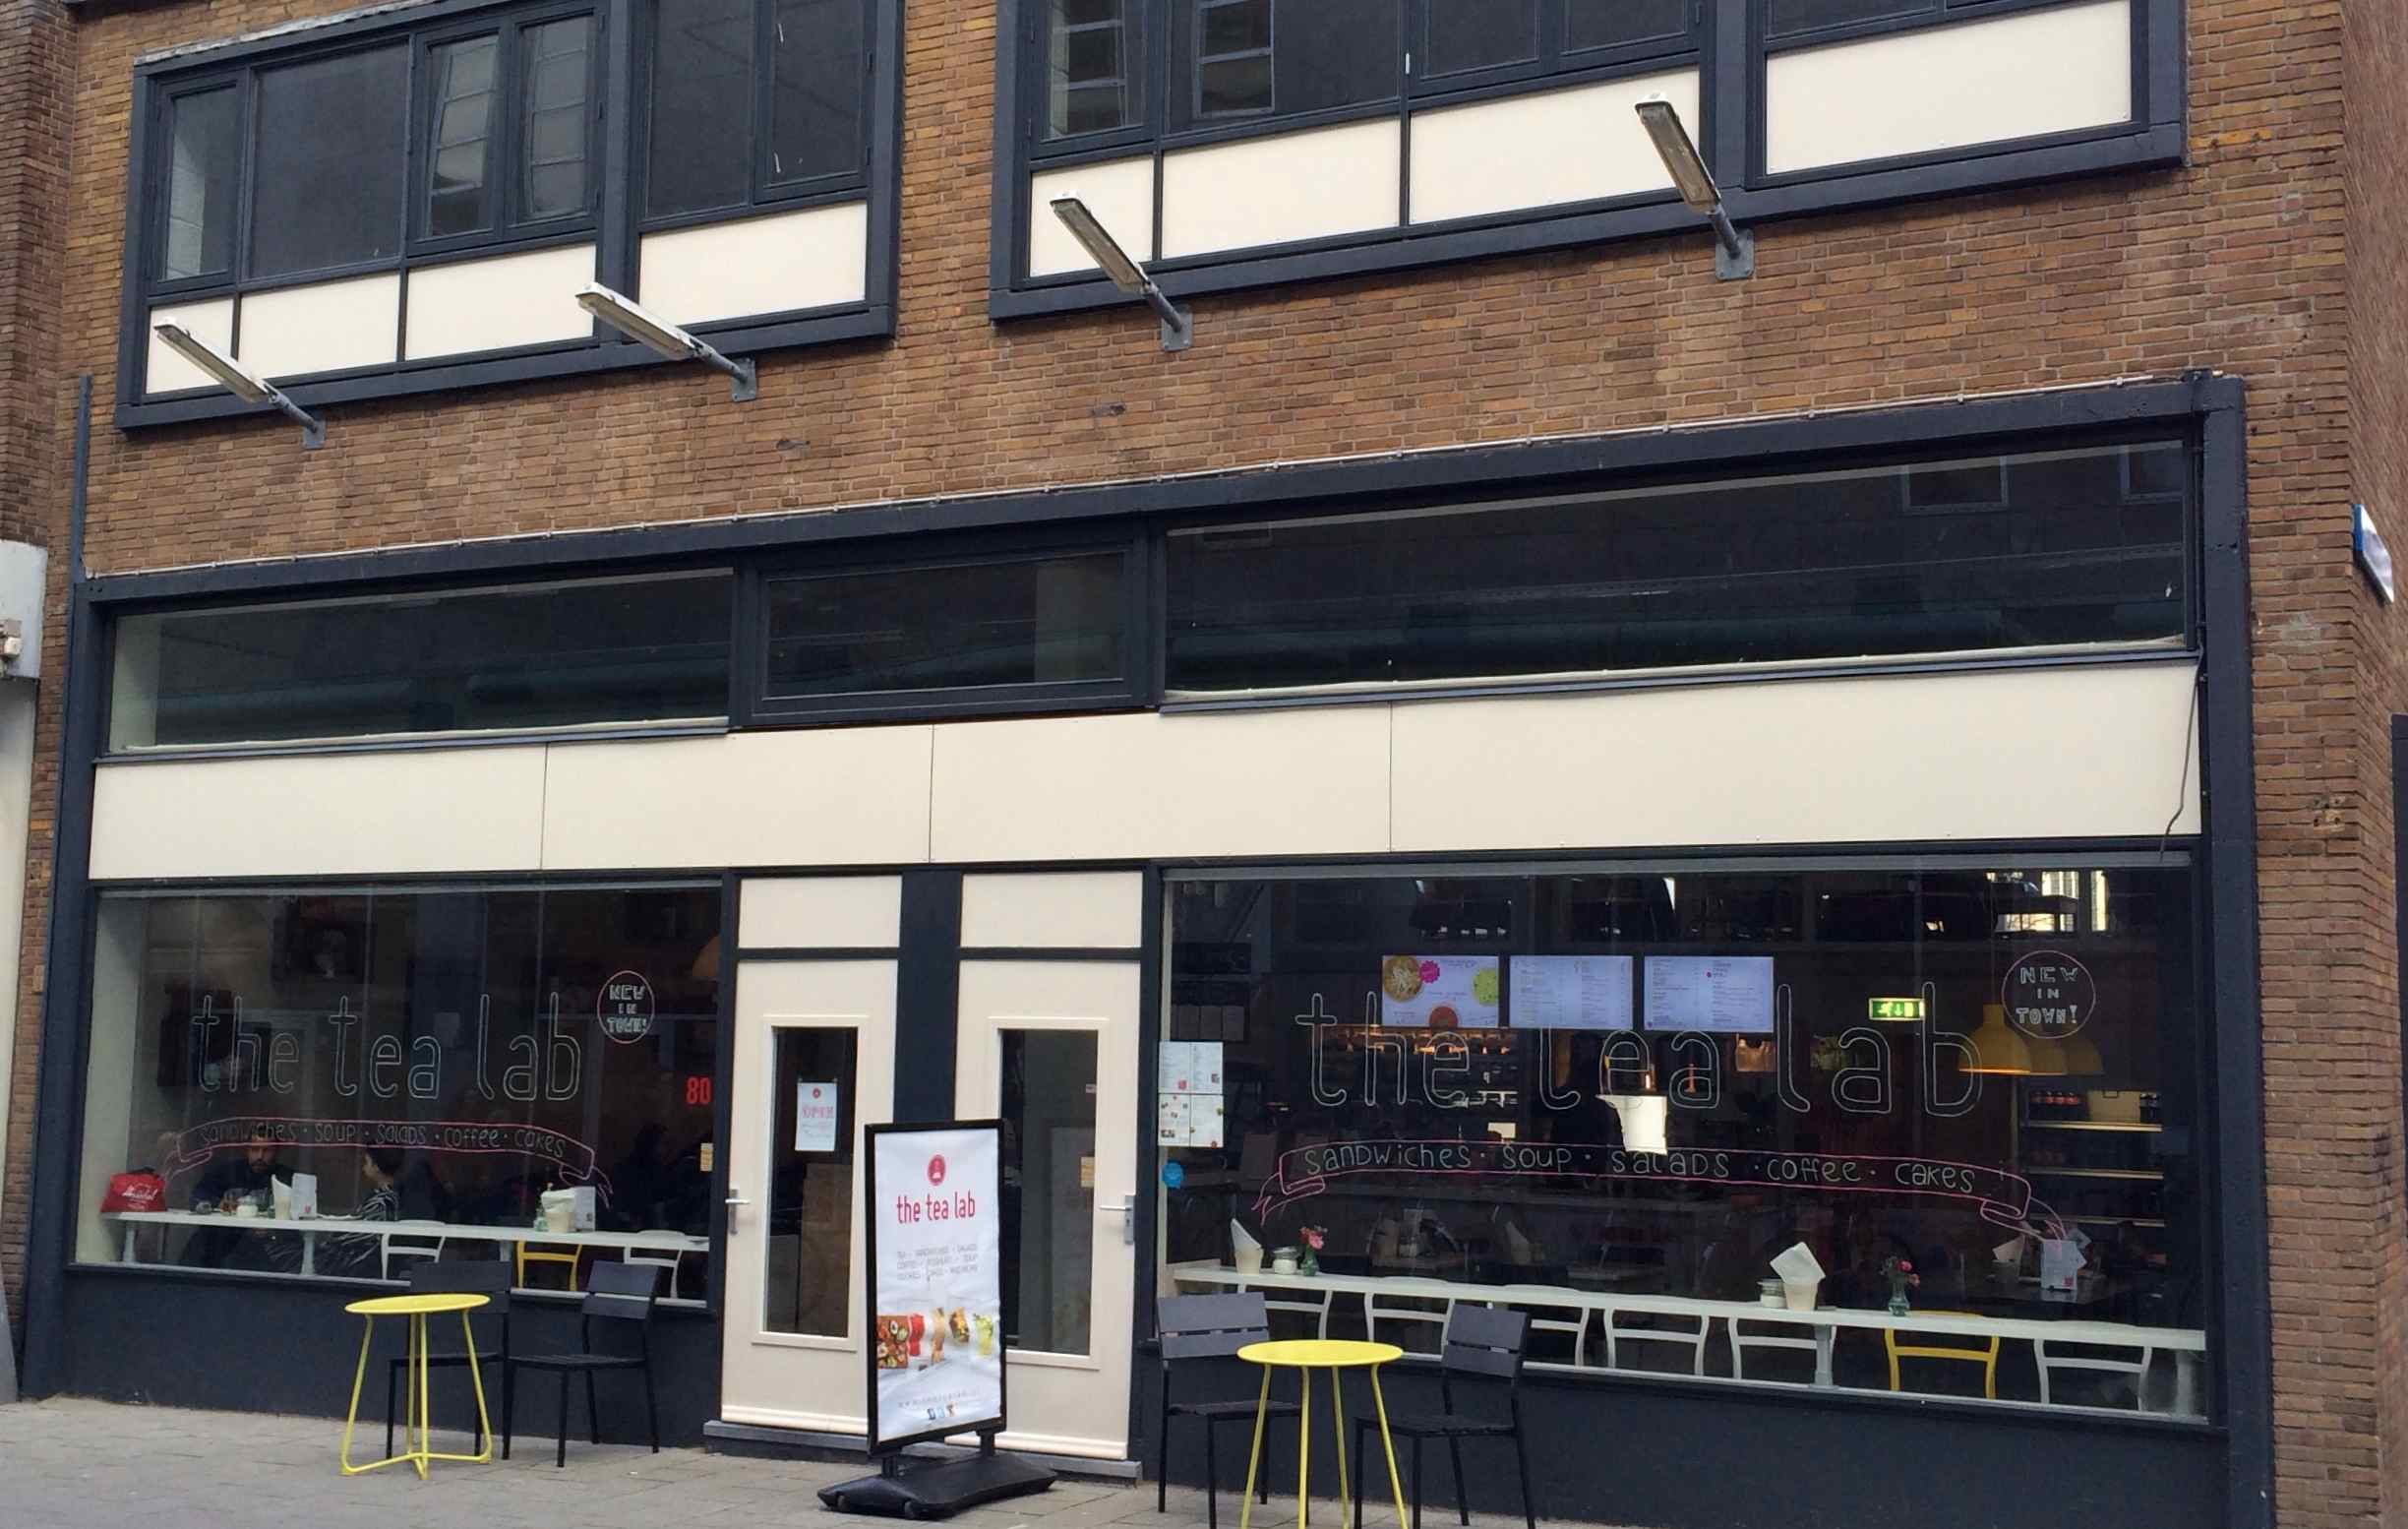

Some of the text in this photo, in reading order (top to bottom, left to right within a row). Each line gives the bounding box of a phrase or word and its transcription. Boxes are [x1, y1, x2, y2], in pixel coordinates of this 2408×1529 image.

[2019, 966, 2078, 985] NEW
[2037, 988, 2060, 1000] IN
[2016, 1005, 2078, 1025] TOWN!
[192, 992, 581, 1101] the tea lab
[1295, 991, 1471, 1109] the
[1776, 982, 1982, 1118] lab
[896, 1189, 976, 1224] the tea lab
